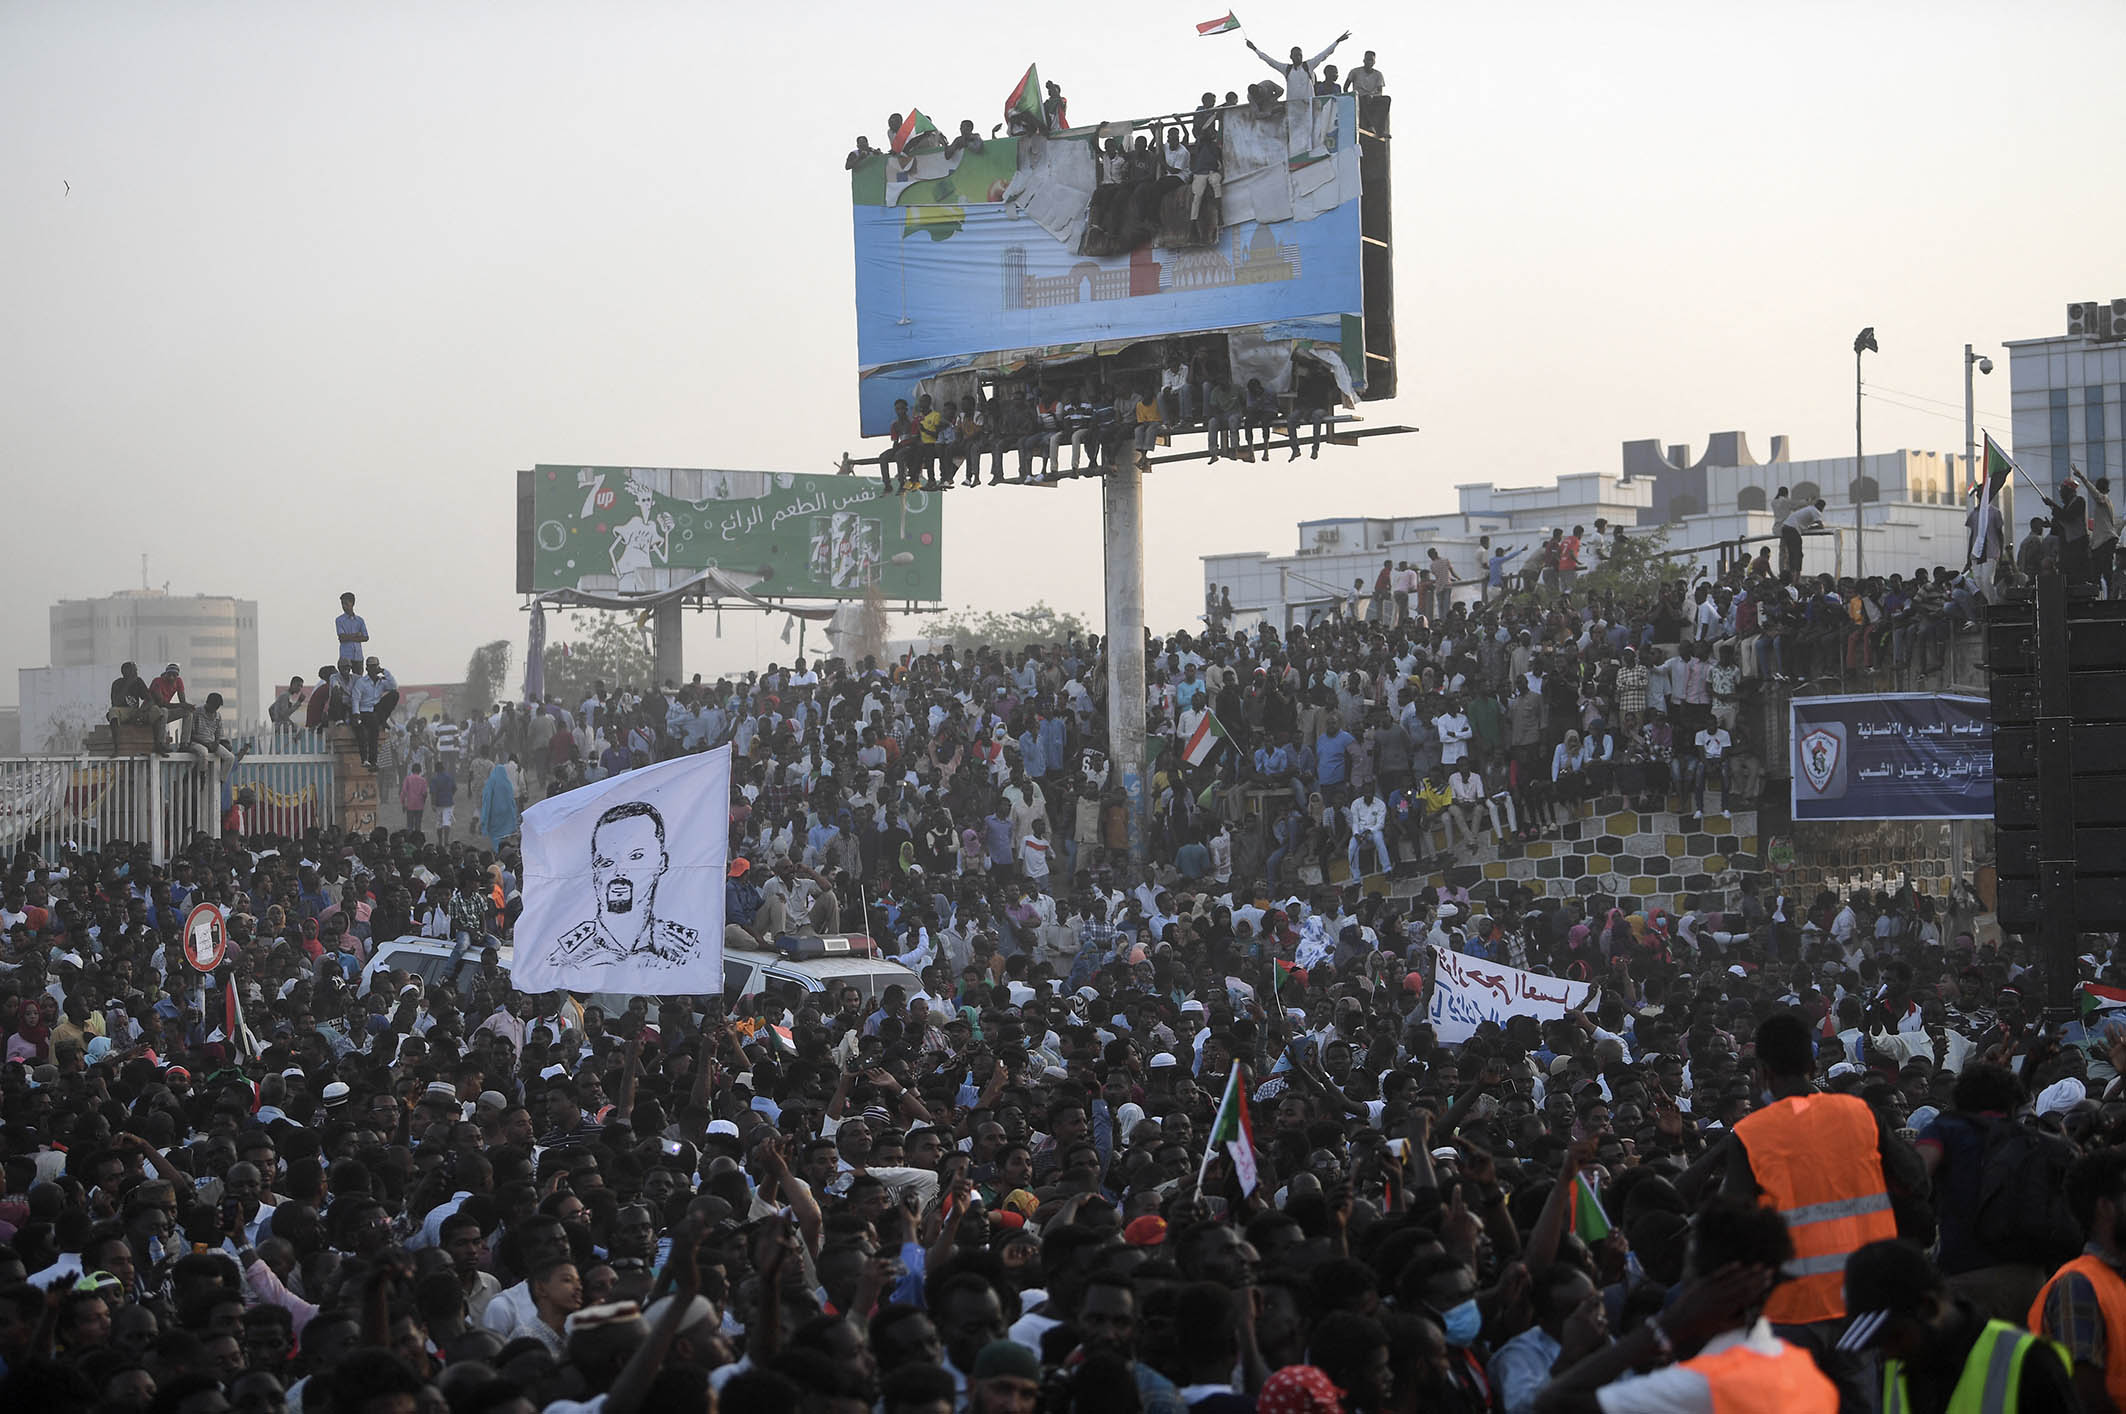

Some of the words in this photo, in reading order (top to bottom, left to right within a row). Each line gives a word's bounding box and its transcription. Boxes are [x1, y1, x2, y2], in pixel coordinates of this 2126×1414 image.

[832, 487, 876, 510] نفس
[771, 492, 827, 532] الطعم
[720, 505, 763, 541] الرائع
[1906, 725, 1914, 739] و
[1917, 721, 1947, 738] الحب
[1858, 761, 1893, 779] الشعب
[1898, 761, 1925, 778] خيار
[1933, 760, 1972, 778] الثورة
[1977, 764, 1984, 778] و
